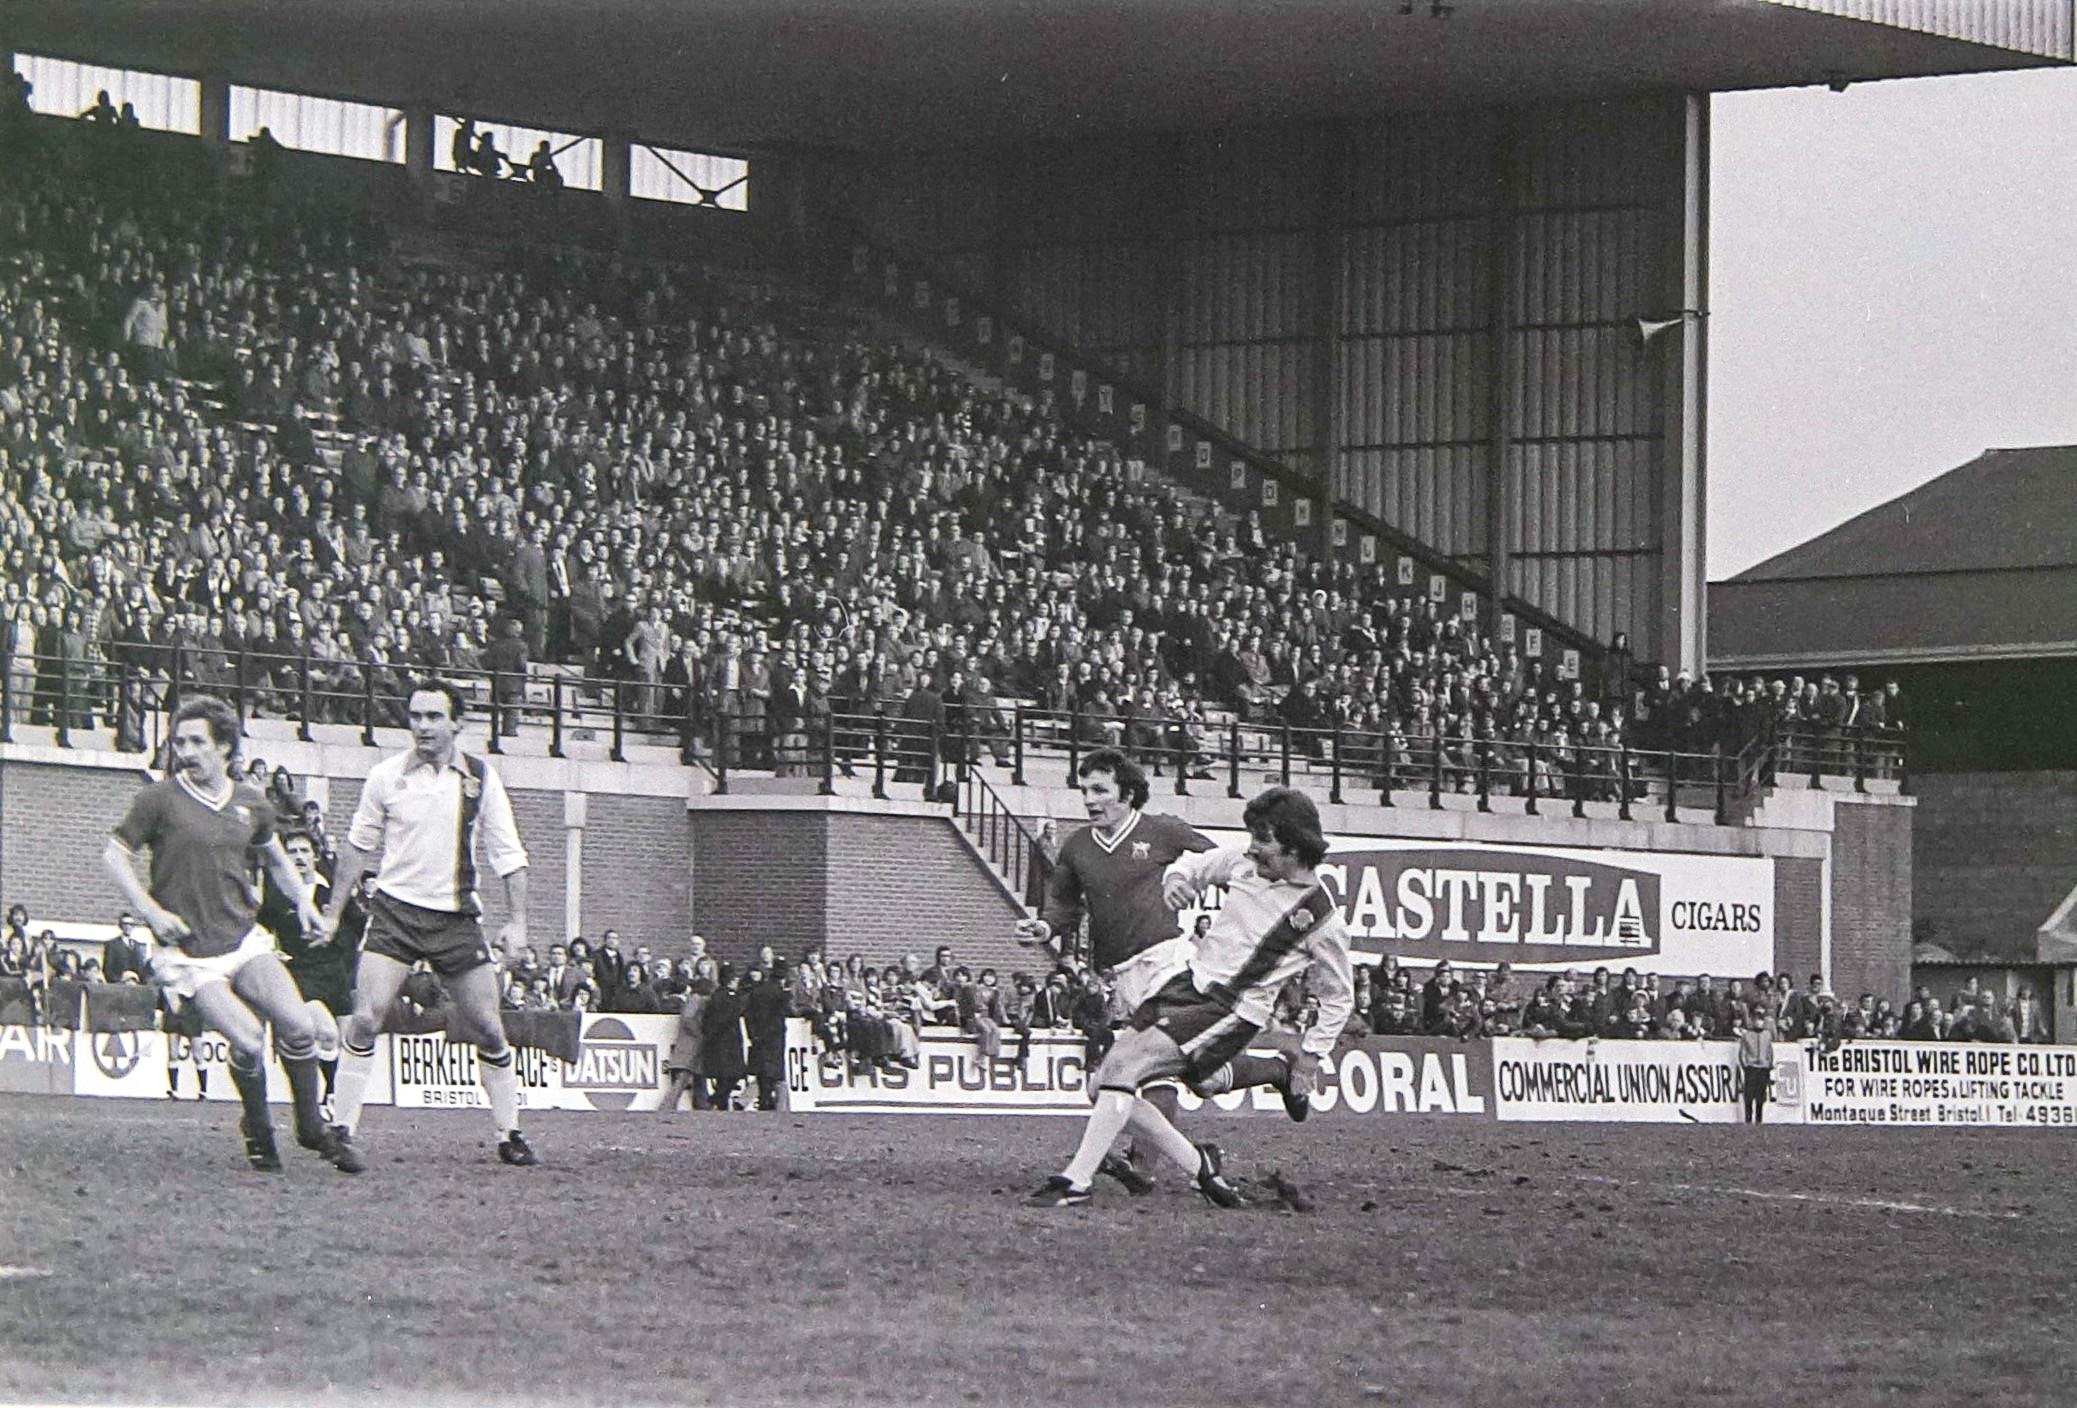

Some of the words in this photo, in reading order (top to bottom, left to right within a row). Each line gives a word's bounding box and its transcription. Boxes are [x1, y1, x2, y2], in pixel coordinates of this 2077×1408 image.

[1672, 900, 1761, 933] CIGARS
[0, 1024, 71, 1064] AIR
[400, 1037, 477, 1086] BERKELE
[1804, 1046, 1839, 1072] The
[1842, 1048, 1912, 1073] BRISTOL
[1916, 1050, 1960, 1075] WIRE
[1966, 1051, 2011, 1076] ROPE
[564, 1048, 656, 1084] DATSUN
[929, 1054, 1083, 1092] PUBLIC
[1308, 1049, 1484, 1114] CORAL
[1499, 1060, 1615, 1103] COMMERCIAL
[1617, 1063, 1670, 1104] UNION
[1674, 1063, 1777, 1103] ASSURAE
[1825, 1078, 1855, 1097] FOR
[1860, 1078, 1898, 1098] WIRE
[1902, 1079, 1949, 1098] ROPES
[1959, 1080, 2009, 1099] LIFTING
[2013, 1081, 2064, 1100] TACKLE
[1890, 1103, 1931, 1121] Street
